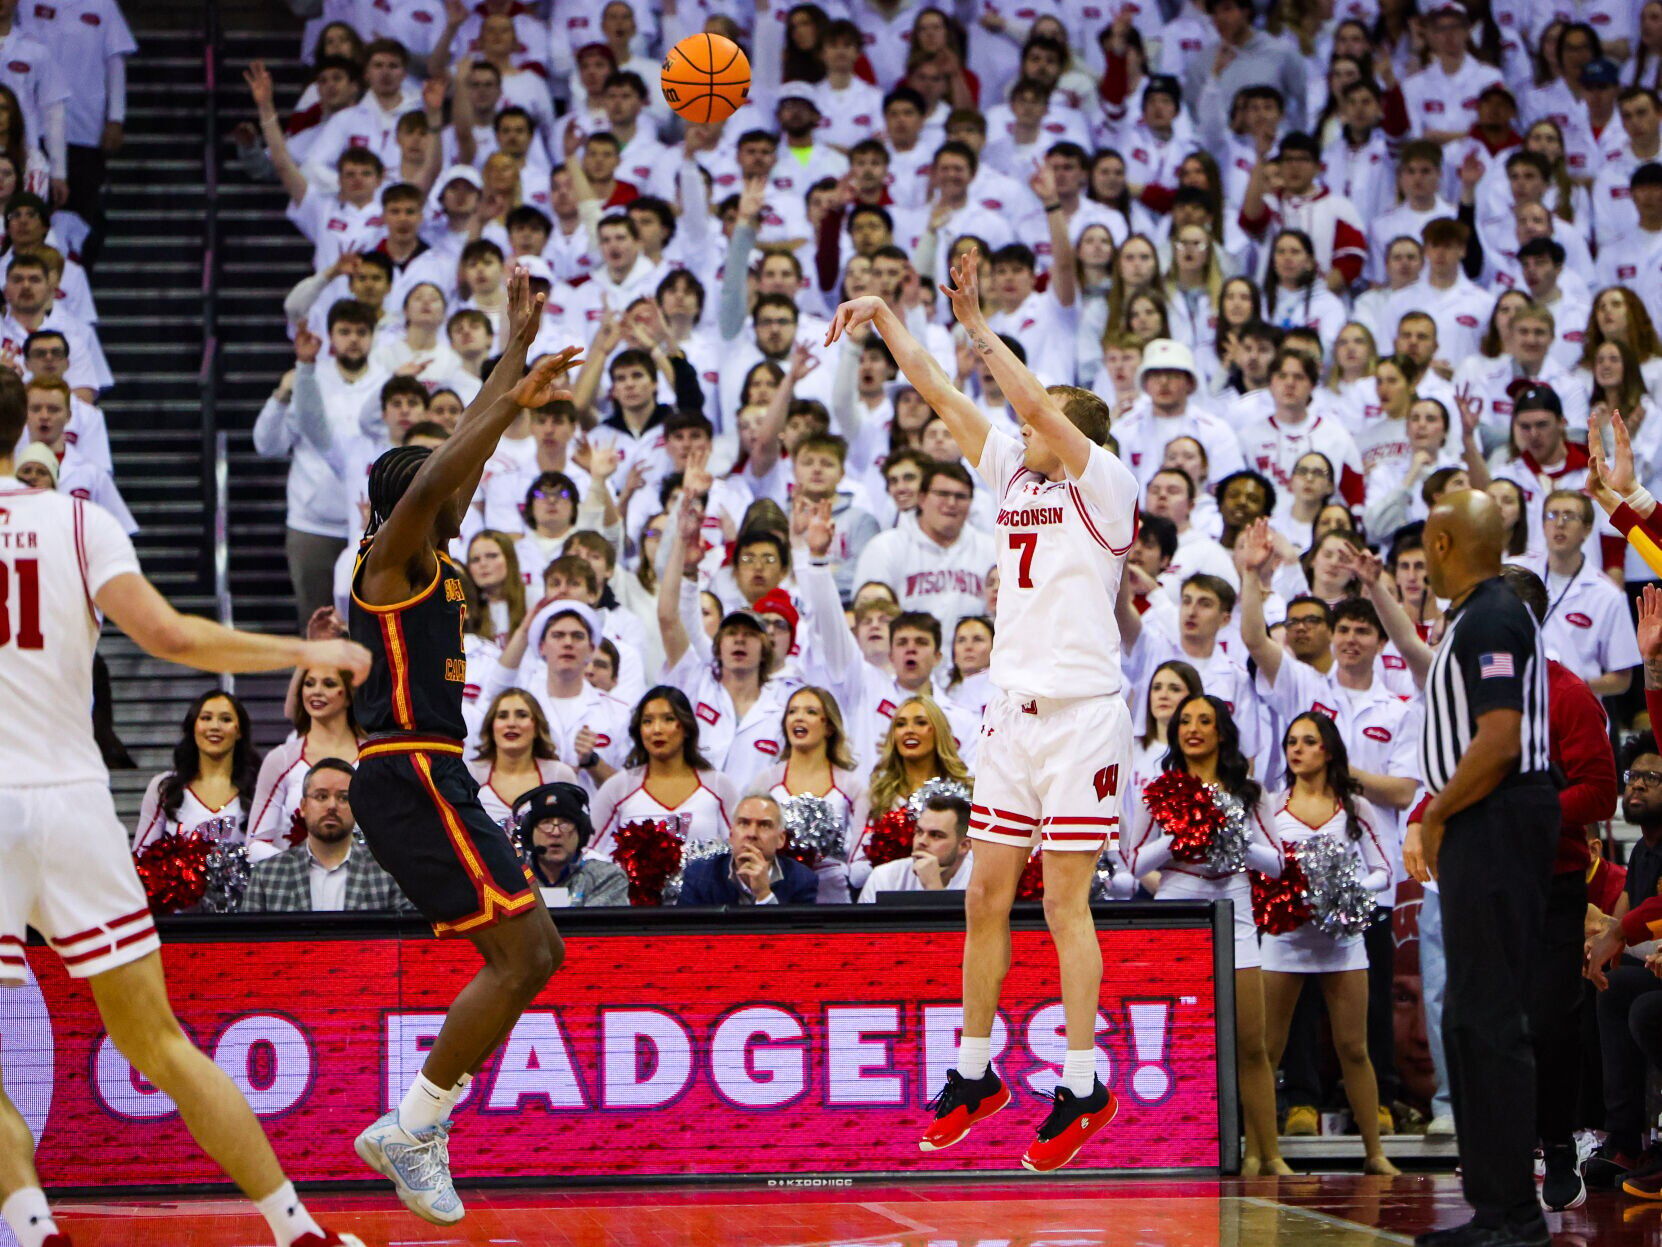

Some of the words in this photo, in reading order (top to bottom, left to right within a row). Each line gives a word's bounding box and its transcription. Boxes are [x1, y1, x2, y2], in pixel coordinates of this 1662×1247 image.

[996, 507, 1064, 527] WSCONSIN
[1008, 532, 1038, 588] 7
[1092, 763, 1119, 803] W
